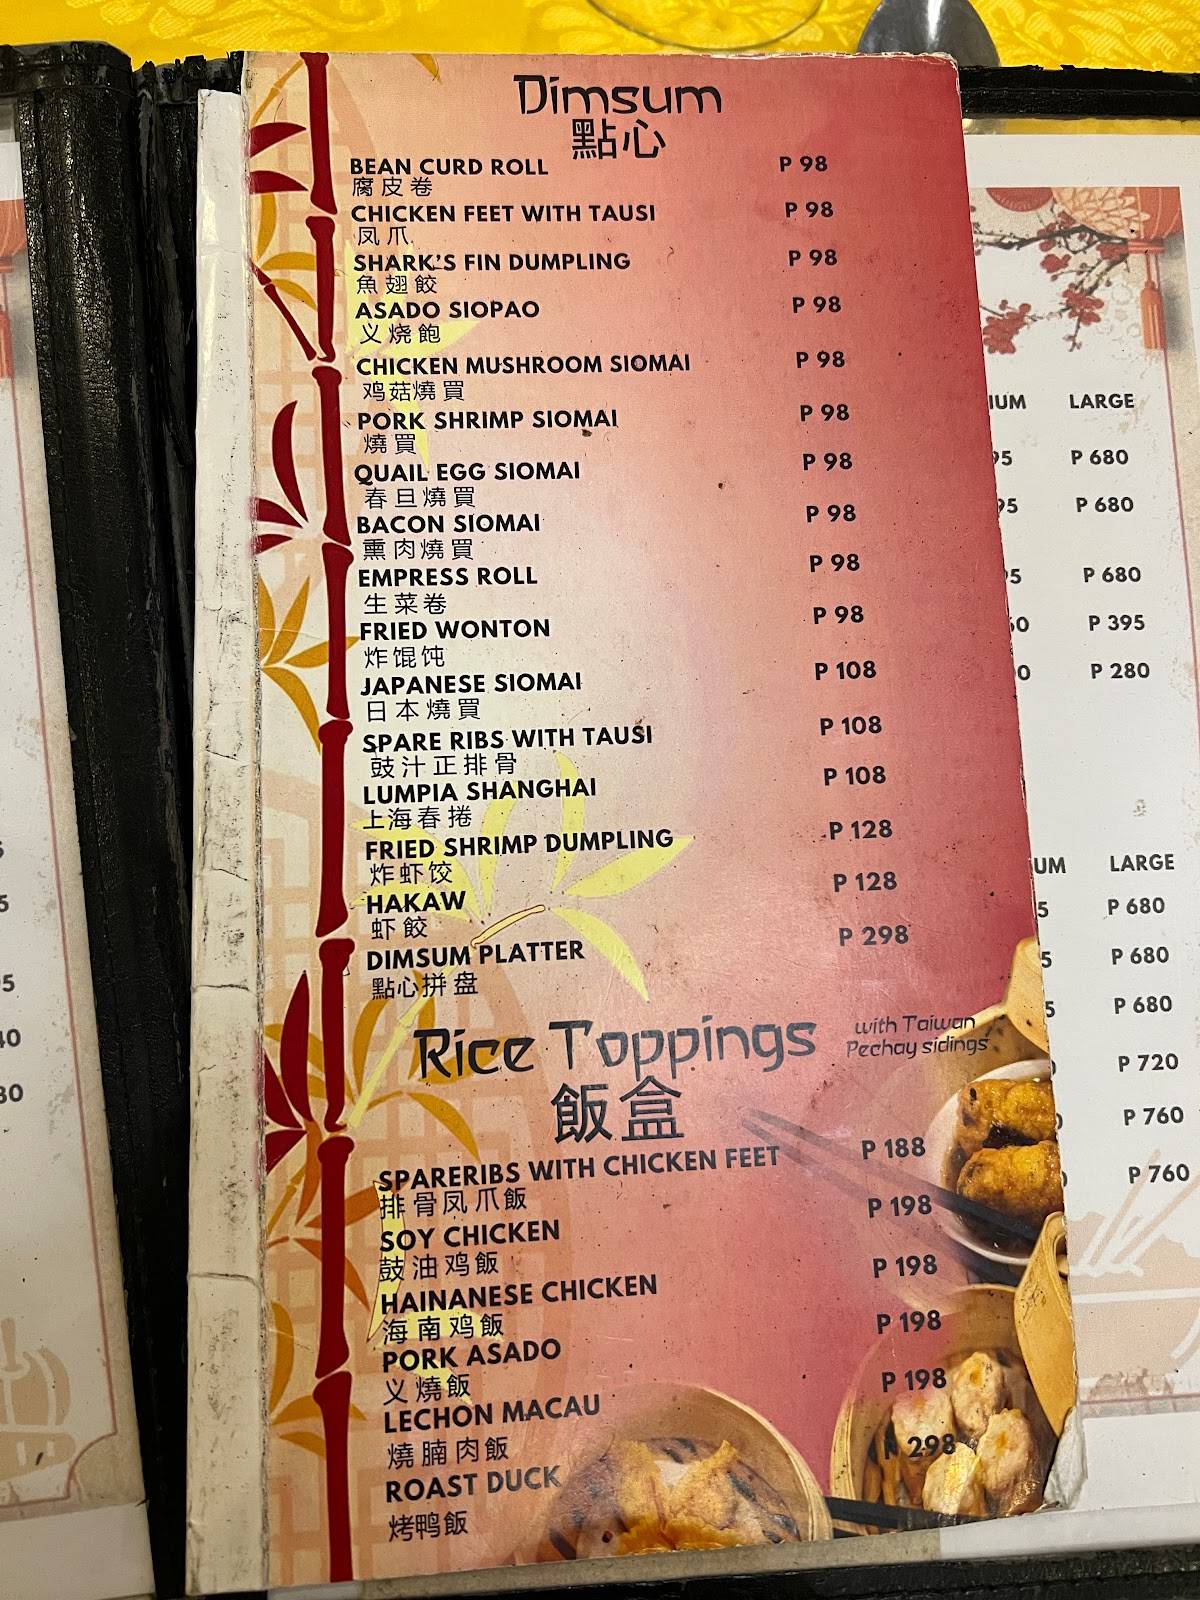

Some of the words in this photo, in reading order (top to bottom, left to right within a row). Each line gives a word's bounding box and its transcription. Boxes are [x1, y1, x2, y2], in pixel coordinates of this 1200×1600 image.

[513, 75, 721, 114] Dimsum
[572, 118, 666, 160] 點心
[351, 158, 411, 175] BEAN
[420, 159, 482, 175] CURD
[491, 159, 548, 175] ROLL
[780, 156, 791, 172] P
[800, 156, 827, 172] 98
[352, 176, 432, 196] 腐皮卷
[351, 206, 455, 222] CHICKEN
[464, 205, 514, 222] FEET
[521, 205, 580, 223] WITH
[589, 205, 655, 221] TAUSI
[785, 202, 797, 218] P
[806, 201, 833, 217] 98
[358, 226, 408, 246] 凤爪
[465, 254, 500, 271] FIN
[509, 253, 630, 270] DUMPLING
[789, 250, 801, 266] P
[809, 249, 837, 266] 98
[357, 274, 437, 294] 魚翅餃
[355, 302, 440, 319] ASADO
[449, 300, 539, 318] SIOPAO
[793, 297, 805, 313] P
[813, 296, 841, 313] 98
[357, 358, 457, 375] CHICKEN
[466, 356, 602, 374] MUSHROOM
[610, 354, 689, 372] SIOMAI
[796, 352, 808, 368] P
[817, 350, 845, 368] 98
[363, 380, 464, 401] 鸡菇燒買
[1070, 394, 1134, 408] LARGE
[358, 412, 426, 430] PORK
[434, 411, 523, 429] SHRIMP
[532, 410, 618, 428] SIOMAI
[800, 405, 813, 421] P
[821, 404, 849, 421] 98
[364, 433, 416, 454] 燒買
[803, 454, 815, 470] P
[824, 453, 852, 471] 98
[1071, 450, 1082, 465] P
[1090, 450, 1128, 465] 680
[354, 464, 428, 486] QUAIL
[437, 463, 485, 481] EGG
[495, 462, 579, 480] SIOMAI
[365, 487, 475, 509] 春旦燒買
[1076, 498, 1087, 512] P
[1095, 497, 1133, 512] 680
[357, 515, 444, 533] BACON
[454, 514, 539, 532] SIOMAI
[806, 506, 819, 522] P
[828, 504, 856, 522] 98
[810, 555, 822, 572] P
[831, 554, 860, 571] 98
[359, 568, 468, 587] EMPRESS
[478, 567, 537, 585] ROLL
[1084, 568, 1094, 582] P
[1102, 567, 1141, 582] 680
[364, 592, 446, 615] 生菜卷
[813, 607, 826, 624] P
[835, 606, 864, 623] 98
[1089, 615, 1100, 631] P
[1108, 615, 1145, 630] 395
[360, 622, 427, 640] FRIED
[435, 619, 549, 639] WONTON
[364, 645, 444, 669] 炸馄饨
[815, 663, 828, 680] P
[837, 660, 876, 679] 108
[1091, 664, 1102, 679] P
[1110, 663, 1149, 678] 280
[360, 675, 485, 696] JAPANESE
[495, 672, 581, 692] SIOMAI
[368, 698, 480, 722] 日本燒買
[820, 718, 833, 736] P
[842, 716, 882, 734] 108
[363, 733, 441, 754] SPARE
[451, 730, 504, 751] RIBS
[512, 728, 574, 747] WITH
[582, 725, 652, 745] TAUSI
[824, 768, 837, 786] P
[846, 766, 886, 785] 108
[364, 783, 458, 804] LUMPIA
[467, 778, 595, 800] SHANGHAI
[363, 805, 471, 830] 上海春捲
[829, 822, 843, 840] P
[851, 820, 892, 839] 128
[366, 840, 434, 860] FRIED
[444, 835, 537, 857] SHRIMP
[544, 829, 673, 852] DUMPLING
[1111, 854, 1174, 871] LARGE
[370, 861, 452, 886] 炸虾饺
[833, 874, 847, 892] P
[856, 872, 897, 891] 128
[367, 891, 466, 914] HAKAW
[1108, 899, 1119, 915] P
[1127, 897, 1164, 914] 680
[372, 916, 427, 940] 虾餃
[839, 928, 852, 946] P
[862, 925, 908, 945] 298
[367, 946, 470, 970] DIMSUM
[480, 940, 585, 964] PLATTER
[1112, 949, 1123, 965] P
[1131, 947, 1169, 964] 680
[372, 971, 478, 1000] 點心拼盘
[1115, 998, 1125, 1014] P
[1133, 996, 1172, 1013] 680
[856, 1016, 897, 1034] with
[902, 1015, 975, 1032] Taiwan
[413, 1028, 535, 1079] Rice
[549, 1015, 816, 1081] Toppings
[847, 1039, 917, 1059] Pechay
[922, 1036, 990, 1055] sidings
[1119, 1056, 1129, 1072] P
[1138, 1053, 1178, 1071] 720
[551, 1076, 684, 1144] 飯盒
[1124, 1109, 1135, 1126] P
[1143, 1107, 1183, 1125] 760
[862, 1140, 875, 1160] P
[885, 1137, 925, 1158] 188
[378, 1162, 520, 1189] SPARERIBS
[528, 1157, 594, 1181] WITH
[604, 1150, 716, 1176] CHICKEN
[726, 1146, 779, 1168] FEET
[1129, 1167, 1140, 1184] P
[1149, 1164, 1189, 1183] 760
[380, 1187, 527, 1218] 排骨凤爪飯
[868, 1198, 881, 1218] P
[891, 1195, 932, 1216] 198
[380, 1228, 435, 1252] SOY
[444, 1219, 559, 1247] CHICKEN
[873, 1258, 887, 1278] P
[896, 1254, 937, 1276] 198
[382, 1283, 532, 1315] HAINANESE
[542, 1274, 656, 1302] CHICKEN
[383, 1314, 504, 1345] 海南鸡飯
[877, 1314, 890, 1334] P
[900, 1310, 941, 1332] 198
[383, 1346, 458, 1373] PORK
[467, 1338, 561, 1366] ASADO
[882, 1372, 895, 1392] P
[905, 1368, 946, 1390] 198
[385, 1403, 492, 1433] LECHON
[503, 1394, 599, 1423] MACAU
[388, 1437, 509, 1470] 燒腩肉飯
[908, 1436, 956, 1458] 298
[386, 1473, 478, 1503] ROAST
[488, 1466, 559, 1493] DUCK
[389, 1511, 468, 1542] 烤鸭飯
